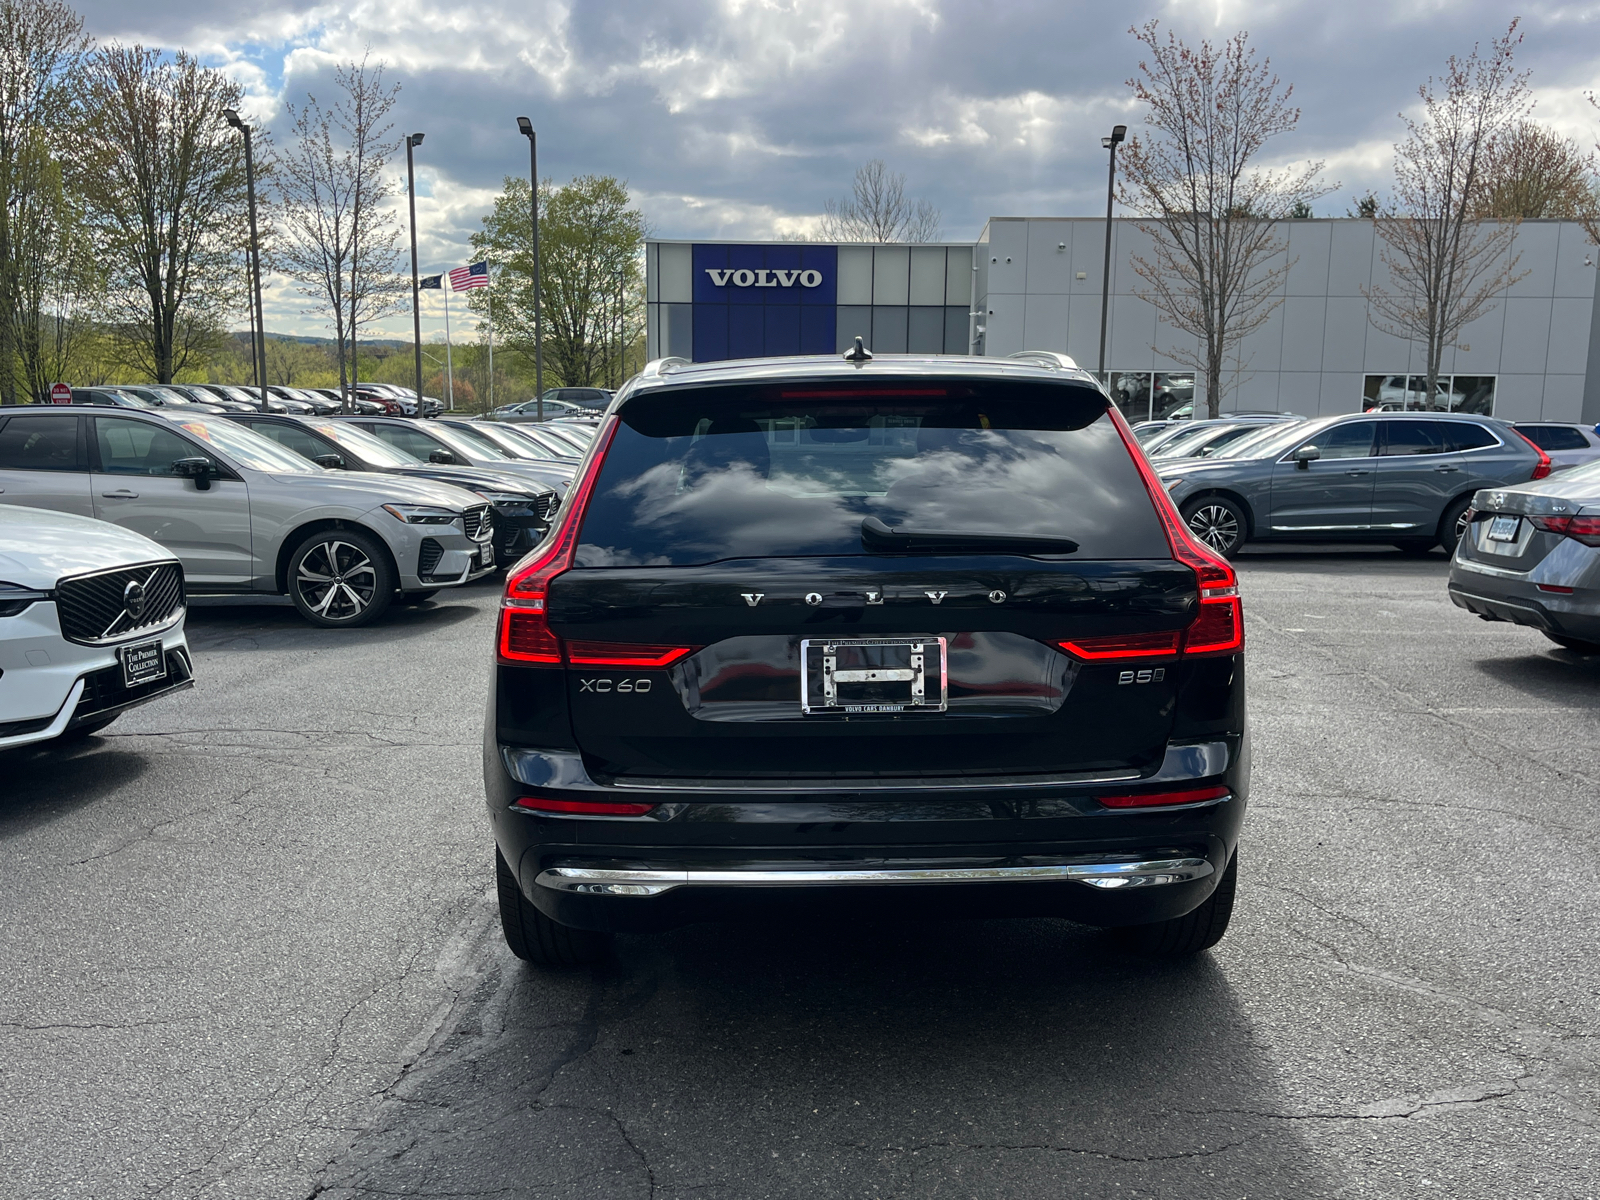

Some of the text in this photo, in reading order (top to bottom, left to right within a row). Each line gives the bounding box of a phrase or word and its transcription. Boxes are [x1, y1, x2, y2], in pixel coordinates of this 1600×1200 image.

[705, 269, 823, 288] VOLVO
[741, 589, 1007, 607] VOLVO
[845, 704, 862, 712] VOLVO
[879, 704, 905, 712] DANBURY
